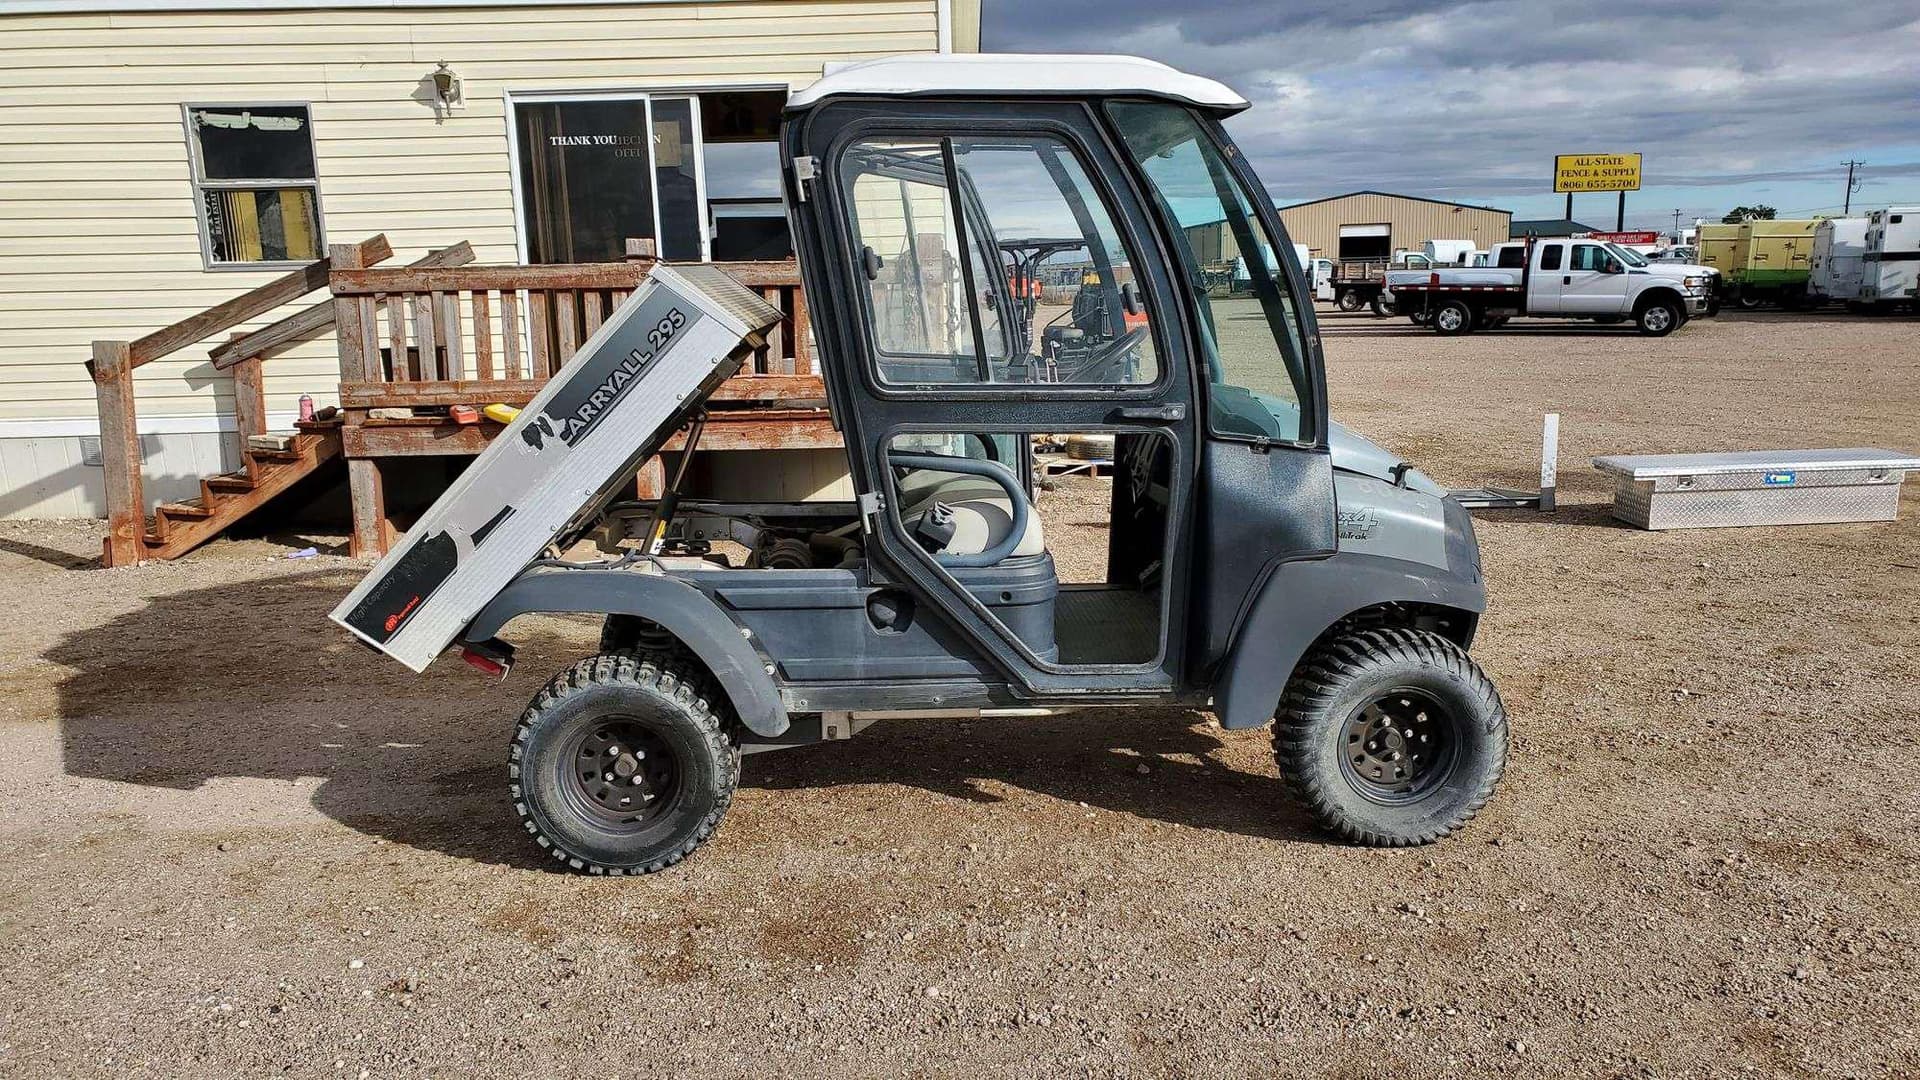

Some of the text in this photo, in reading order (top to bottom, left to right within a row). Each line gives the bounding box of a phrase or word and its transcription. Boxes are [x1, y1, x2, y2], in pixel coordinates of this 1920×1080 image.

[550, 135, 617, 146] THANK YOU
[1574, 157, 1624, 167] ALL-STATE
[1561, 168, 1637, 178] FENCE & SUPPLY
[1560, 179, 1636, 189] (806) 655-5700
[647, 307, 687, 354] 295
